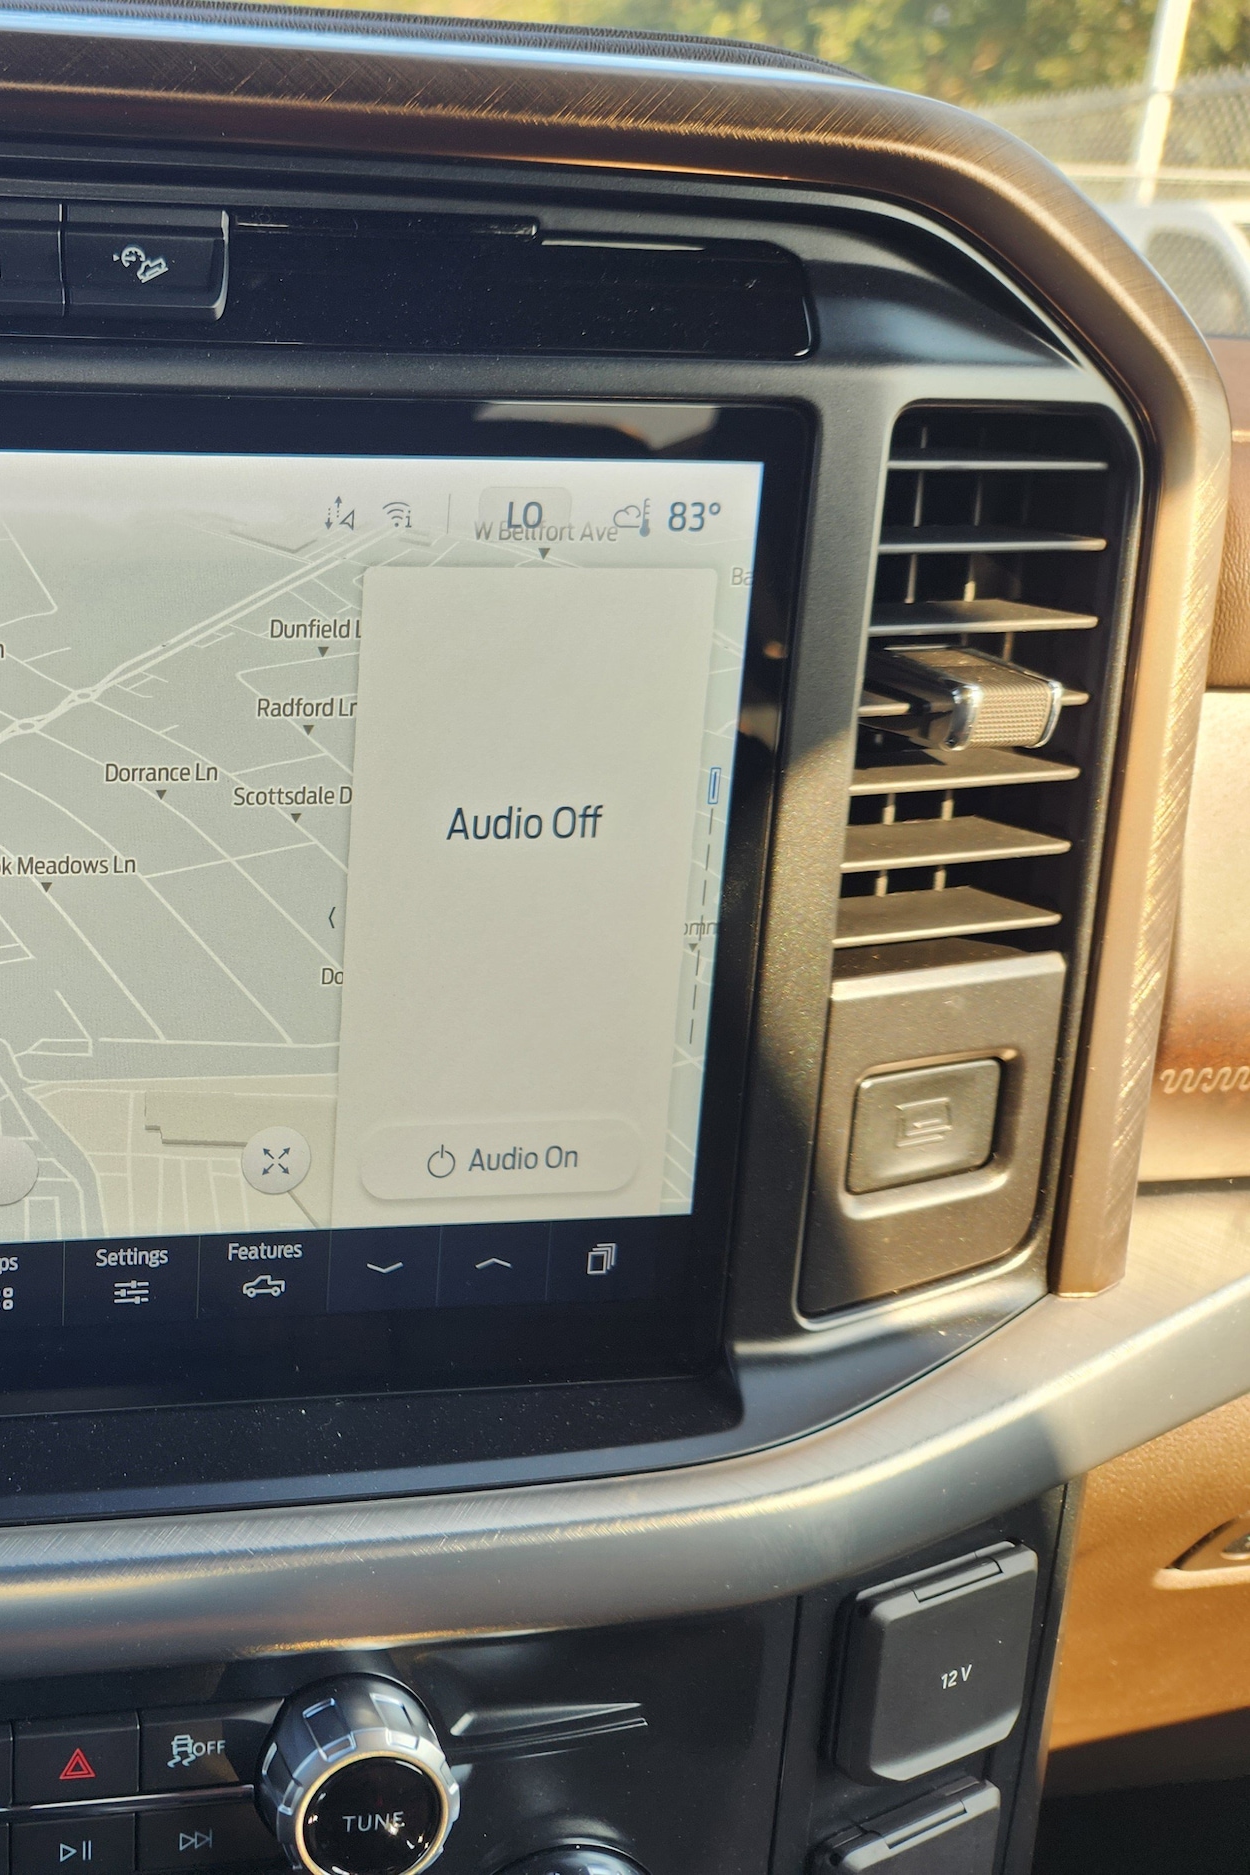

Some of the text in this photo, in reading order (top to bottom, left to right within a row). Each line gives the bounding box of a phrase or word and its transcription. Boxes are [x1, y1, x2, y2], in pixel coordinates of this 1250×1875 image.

[507, 501, 543, 529] LO
[474, 521, 493, 541] W
[579, 521, 618, 541] Ave
[269, 619, 351, 640] Dunfield
[257, 697, 335, 718] Radford
[104, 763, 219, 784] Dorrance Ln
[233, 785, 353, 807] Scottsdale D
[447, 804, 604, 840] Audio Off
[16, 855, 109, 876] Meadows
[113, 855, 137, 875] Ln
[468, 1145, 579, 1172] Audio On
[95, 1246, 169, 1269] Settings
[227, 1241, 304, 1262] Features
[940, 1663, 973, 1690] 12 V
[193, 1739, 227, 1757] OFF
[342, 1811, 405, 1833] TUNE
